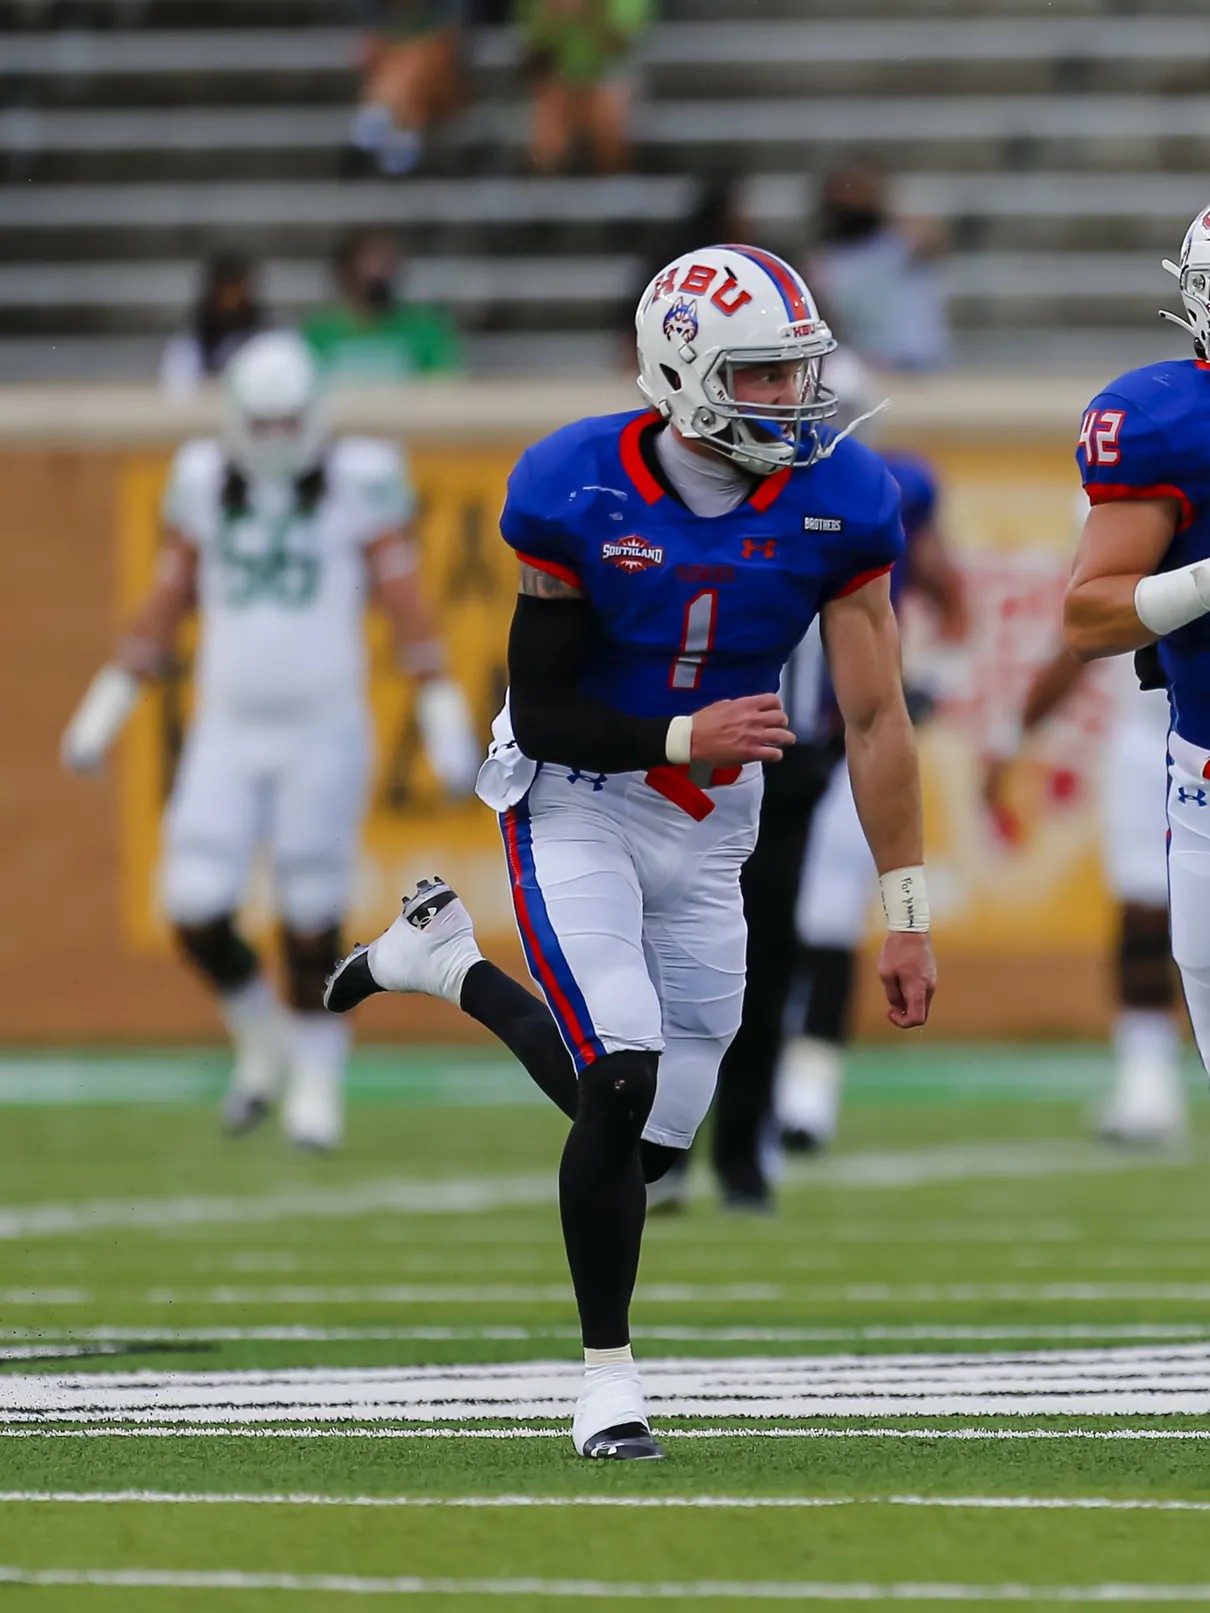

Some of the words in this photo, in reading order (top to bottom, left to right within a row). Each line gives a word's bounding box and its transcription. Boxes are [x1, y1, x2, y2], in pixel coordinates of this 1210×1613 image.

[652, 264, 753, 317] HBU
[793, 324, 816, 338] HBU
[1077, 409, 1127, 466] 42
[804, 517, 841, 531] BROTHERS
[602, 543, 662, 564] SOUTHLAND
[667, 588, 718, 691] 1
